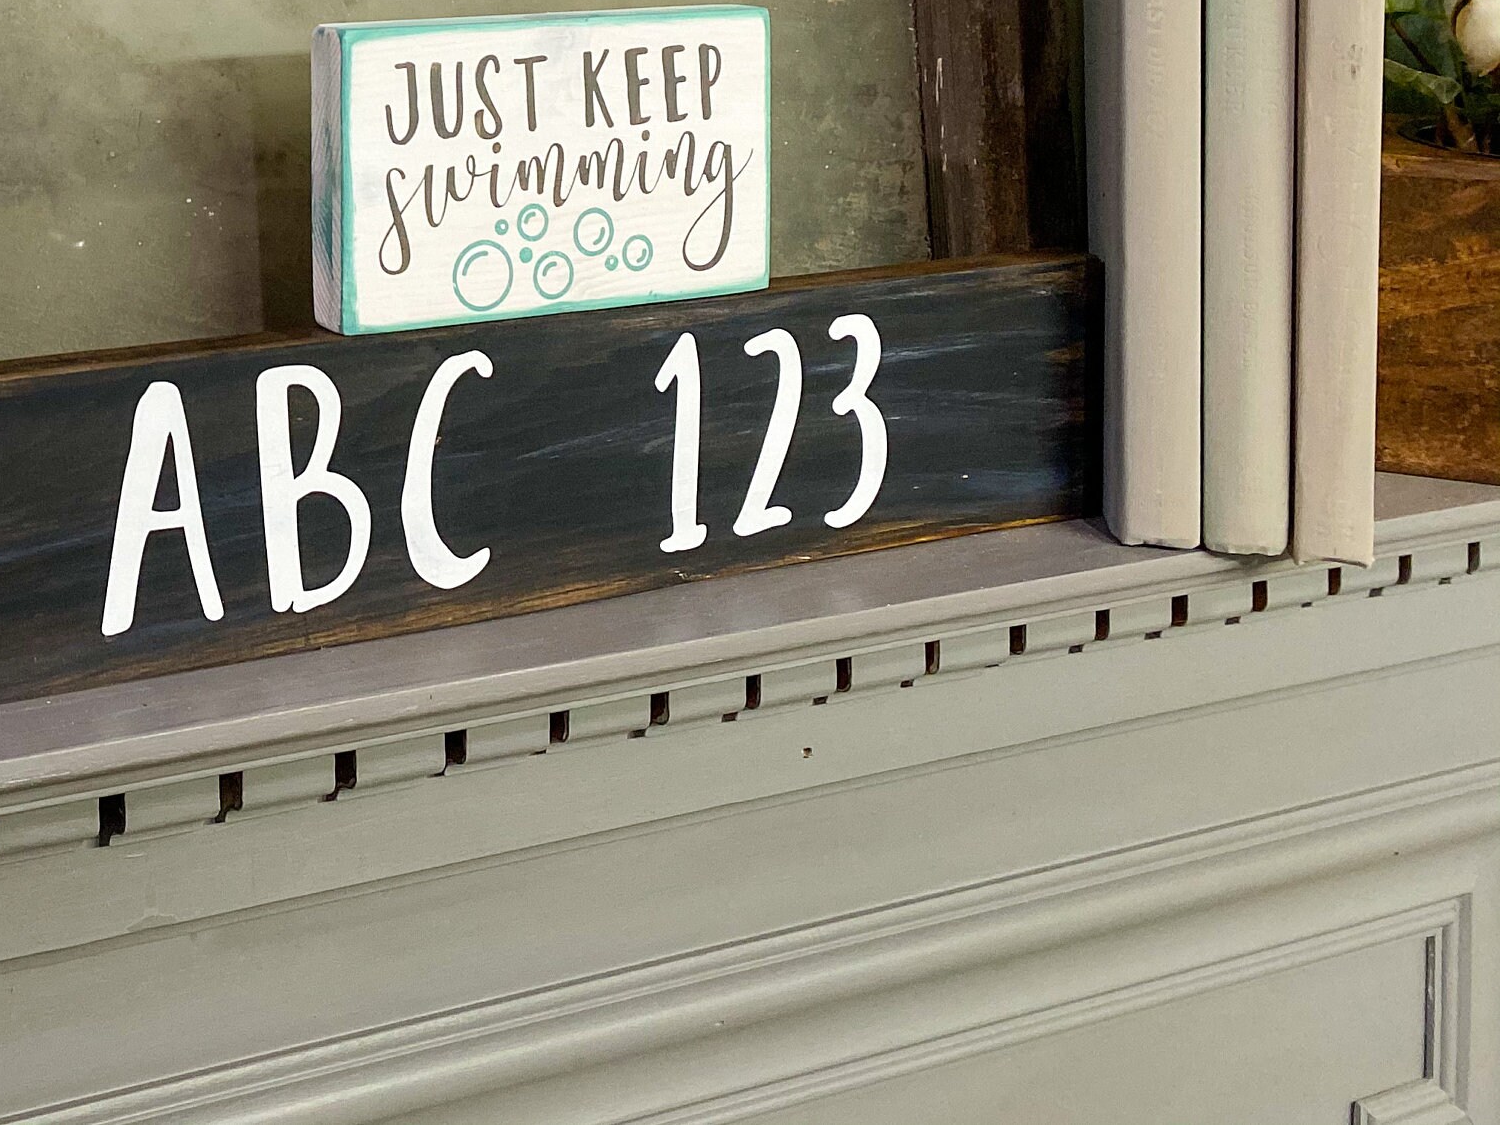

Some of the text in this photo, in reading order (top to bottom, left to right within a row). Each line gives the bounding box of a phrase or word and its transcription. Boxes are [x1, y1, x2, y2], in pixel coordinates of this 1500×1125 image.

[384, 43, 722, 146] JUST KEEP
[378, 129, 754, 276] swimming
[101, 313, 888, 636] ABC 123
